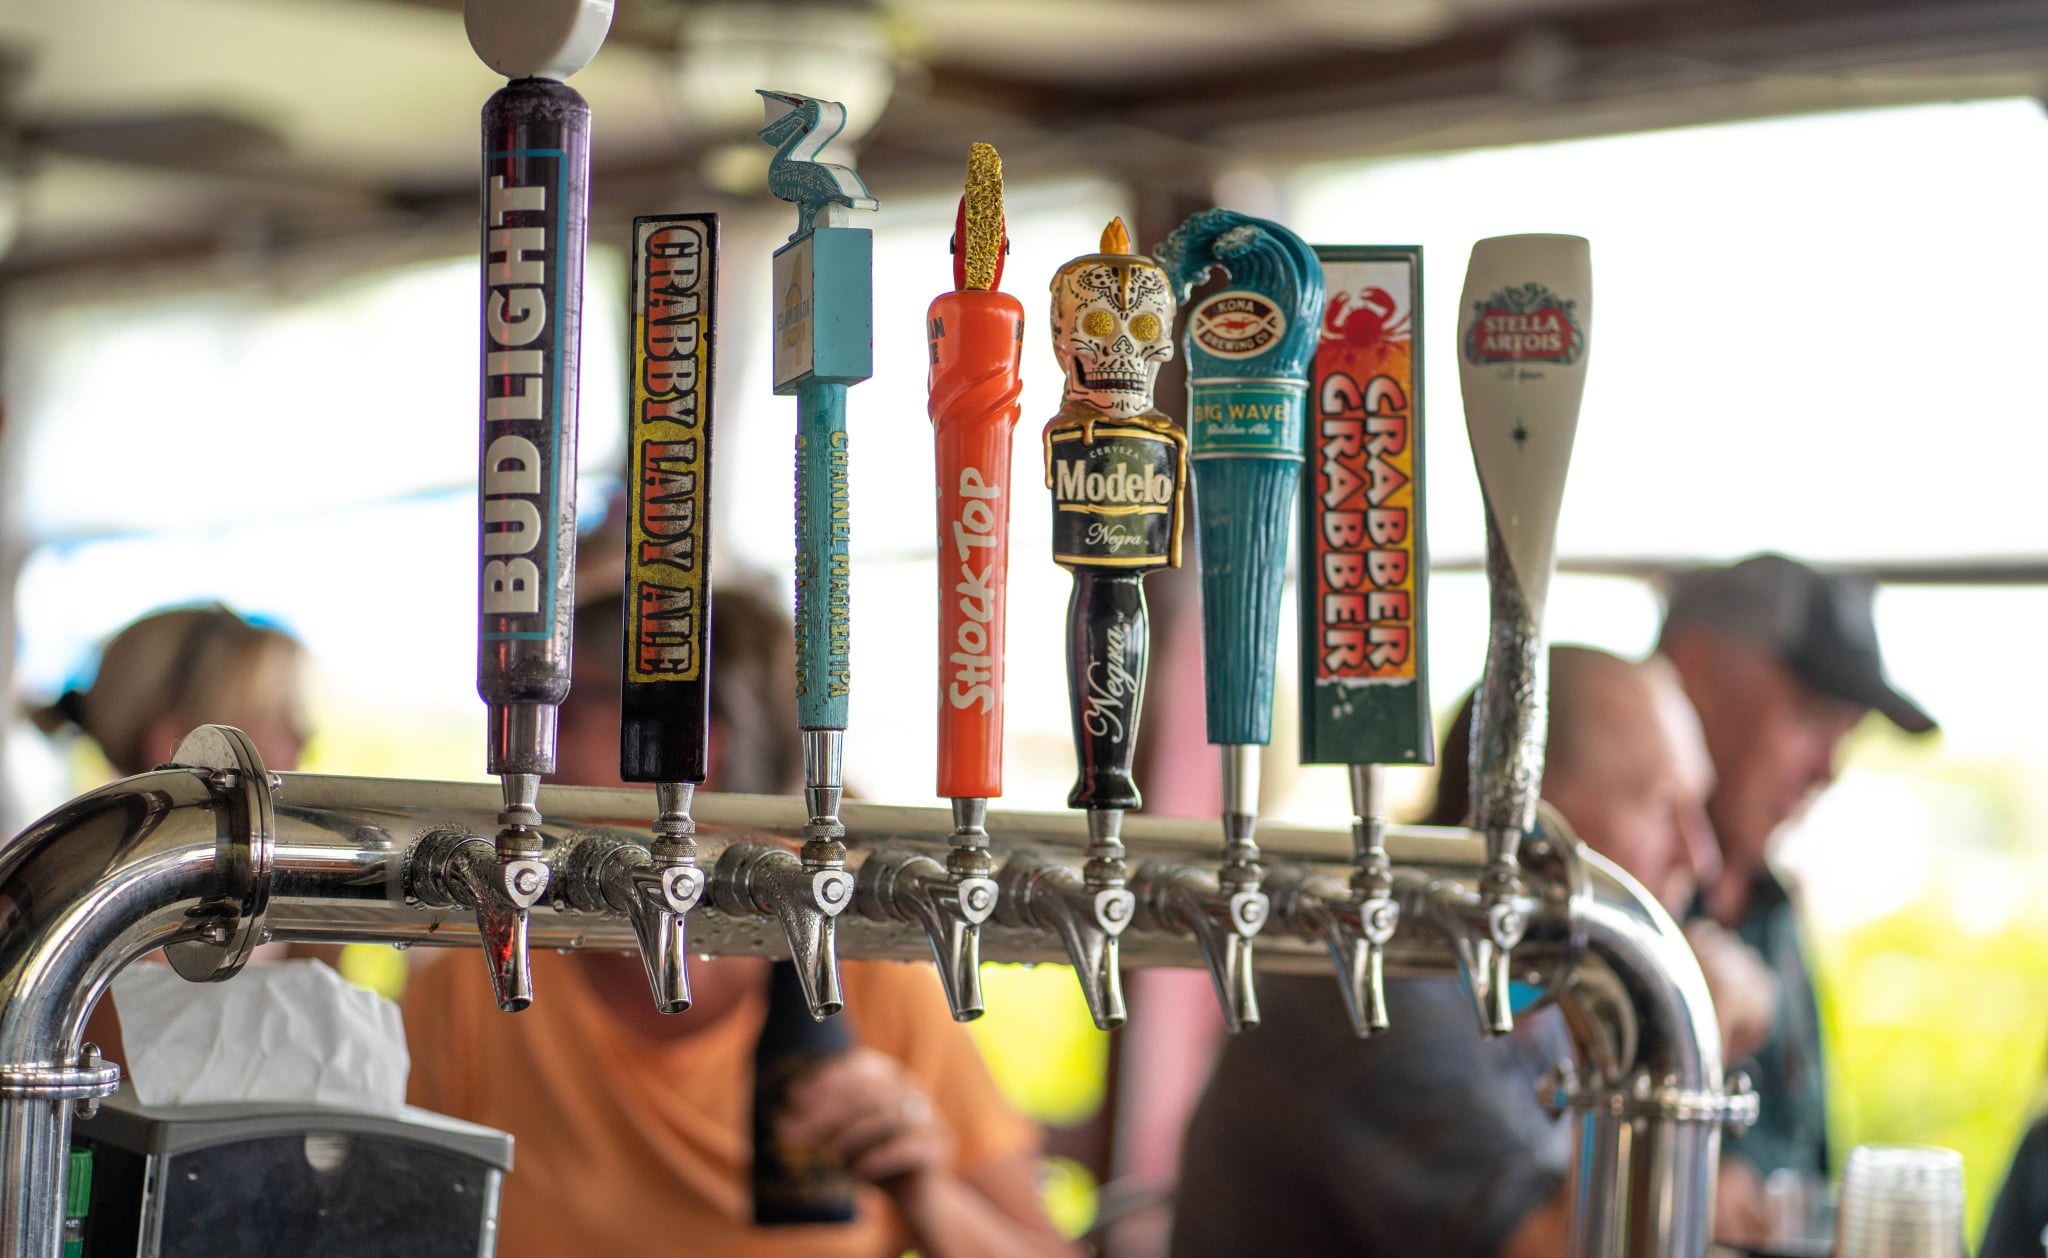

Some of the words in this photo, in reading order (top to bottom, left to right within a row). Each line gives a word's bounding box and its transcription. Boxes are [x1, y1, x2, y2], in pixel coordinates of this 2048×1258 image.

[486, 175, 546, 421] LIGHT
[641, 225, 702, 428] CRABBY
[1203, 331, 1256, 352] BREWING
[1217, 300, 1254, 313] KONA
[1482, 333, 1562, 352] ARTOIS
[1484, 315, 1561, 333] STELLA
[1089, 445, 1140, 459] CERVEZA
[1194, 404, 1223, 424] BIG
[1228, 403, 1285, 422] WAVE
[483, 435, 541, 614] BUD
[638, 438, 697, 572] LADY
[830, 431, 850, 547] CHANNEL
[953, 466, 1001, 562] TOP
[1056, 459, 1172, 504] Modelo
[1321, 372, 1366, 673] CRABBER
[1364, 371, 1409, 671] CRABBER
[1085, 522, 1142, 553] Negra
[636, 581, 694, 675] ALE
[830, 554, 850, 655] MARKER
[950, 563, 996, 715] SHOCK
[829, 660, 850, 698] IPA
[1084, 625, 1137, 744] Negra
